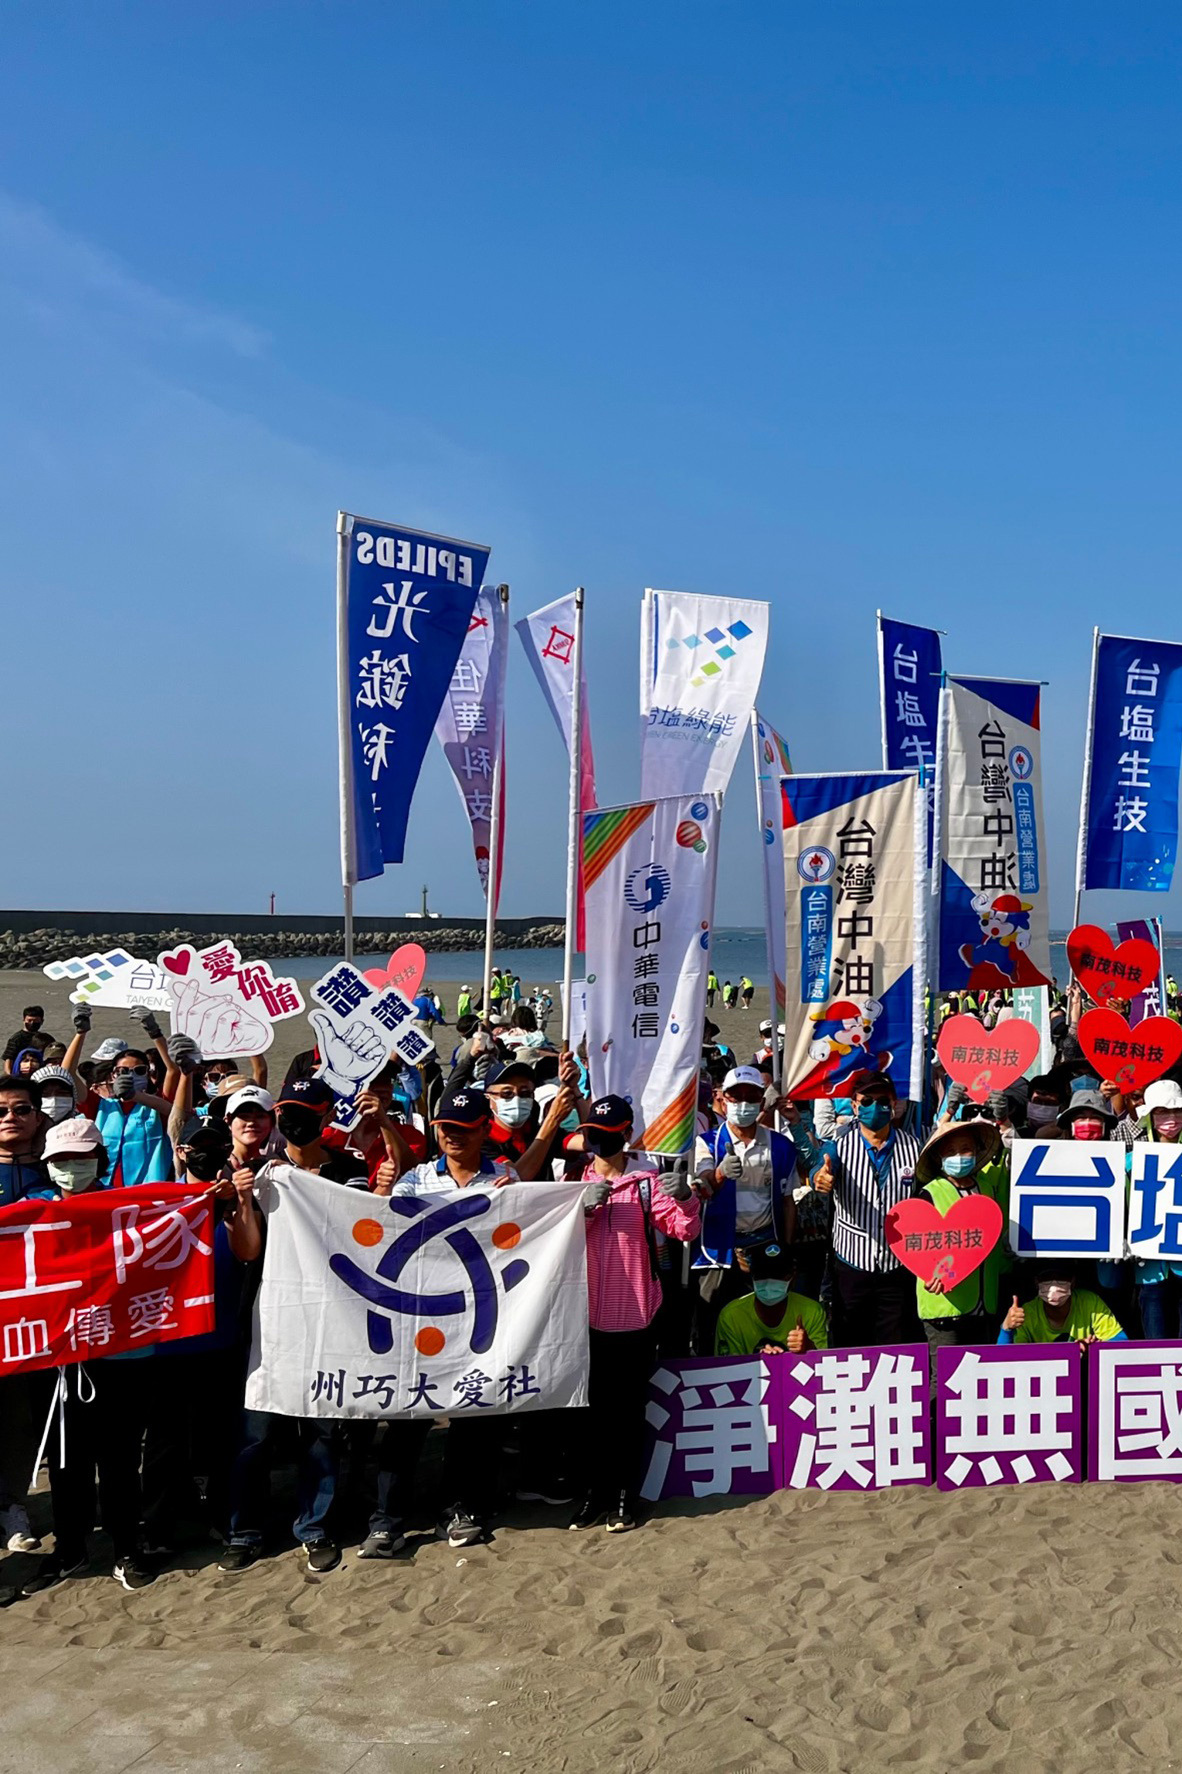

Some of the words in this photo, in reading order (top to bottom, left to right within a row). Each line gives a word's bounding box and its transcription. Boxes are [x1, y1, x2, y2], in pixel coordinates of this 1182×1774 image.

[1112, 658, 1161, 834] 台塩生技
[832, 816, 877, 997] 台灣中油
[806, 890, 828, 999] 台南營業處
[1079, 952, 1143, 983] 南茂科技
[126, 994, 161, 1007] TAIYEN
[200, 945, 300, 1018] 愛你唷
[632, 921, 661, 1039] 中華電信
[951, 1045, 1020, 1068] 南茂科技
[1093, 1037, 1165, 1064] 南茂科技
[904, 1228, 984, 1252] 南茂科技
[310, 1364, 542, 1410] 州巧大愛社
